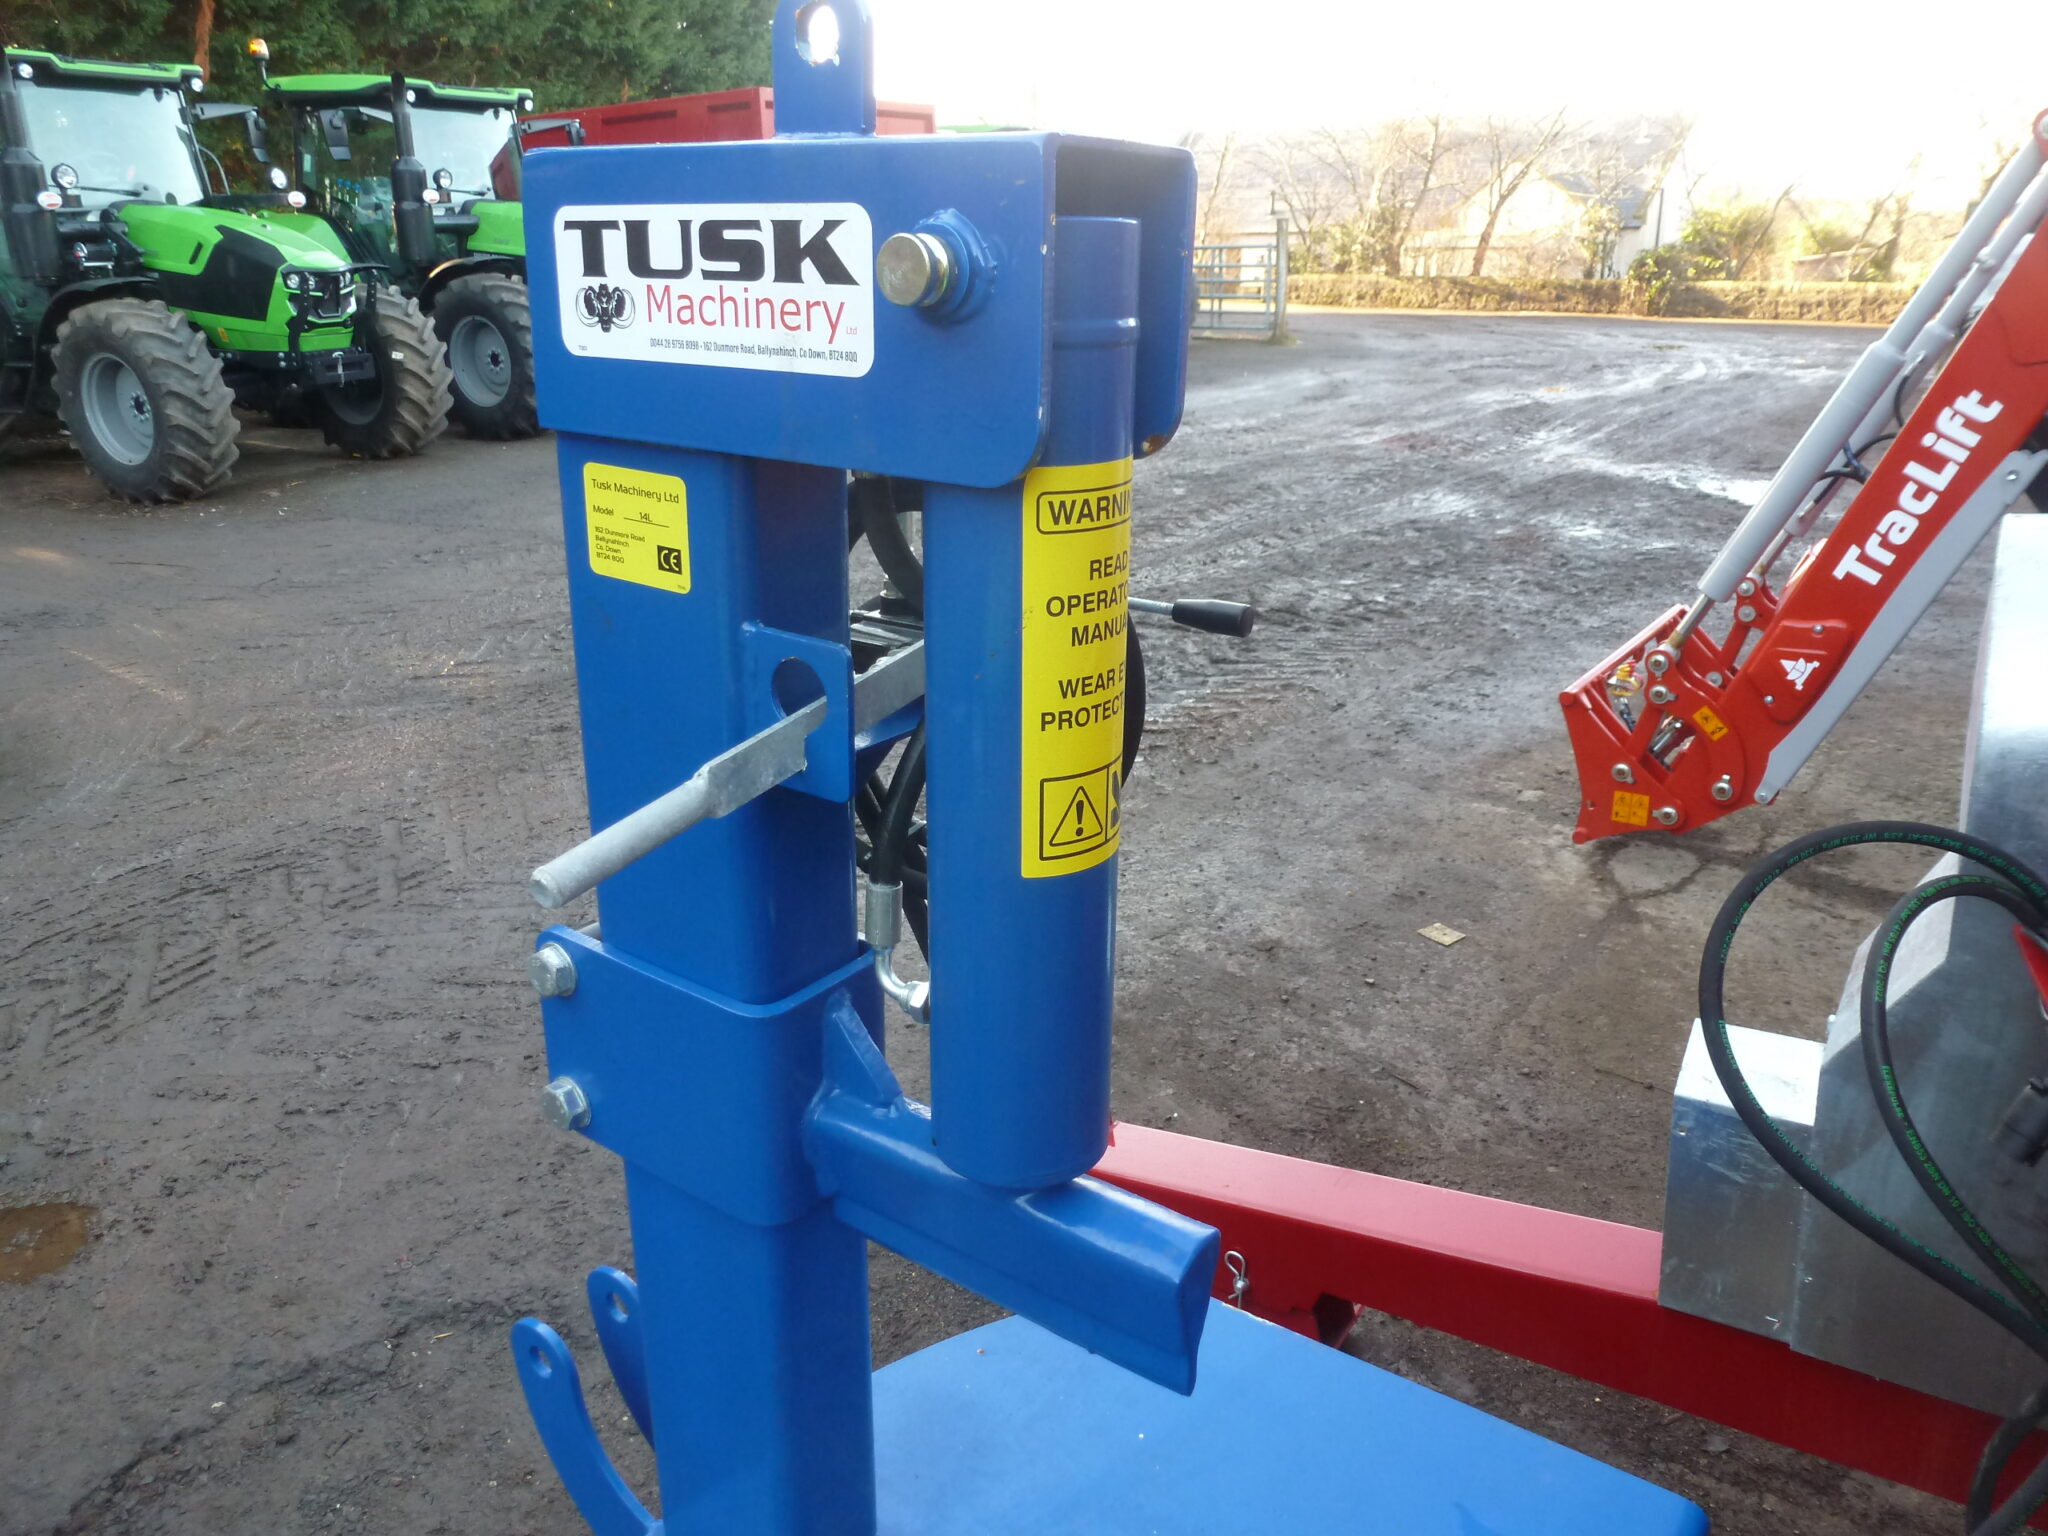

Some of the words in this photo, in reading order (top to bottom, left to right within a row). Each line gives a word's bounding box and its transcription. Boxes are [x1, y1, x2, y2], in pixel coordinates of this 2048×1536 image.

[563, 219, 861, 286] TUSK
[646, 284, 845, 344] Machinery
[713, 342, 739, 353] Dunmore
[591, 478, 612, 491] Tusk
[613, 482, 662, 503] Machinery
[663, 491, 680, 504] Ltd
[1832, 389, 2004, 586] TracLift
[592, 504, 615, 516] Model
[1089, 550, 1129, 581] READ
[1058, 668, 1115, 699] WEAR
